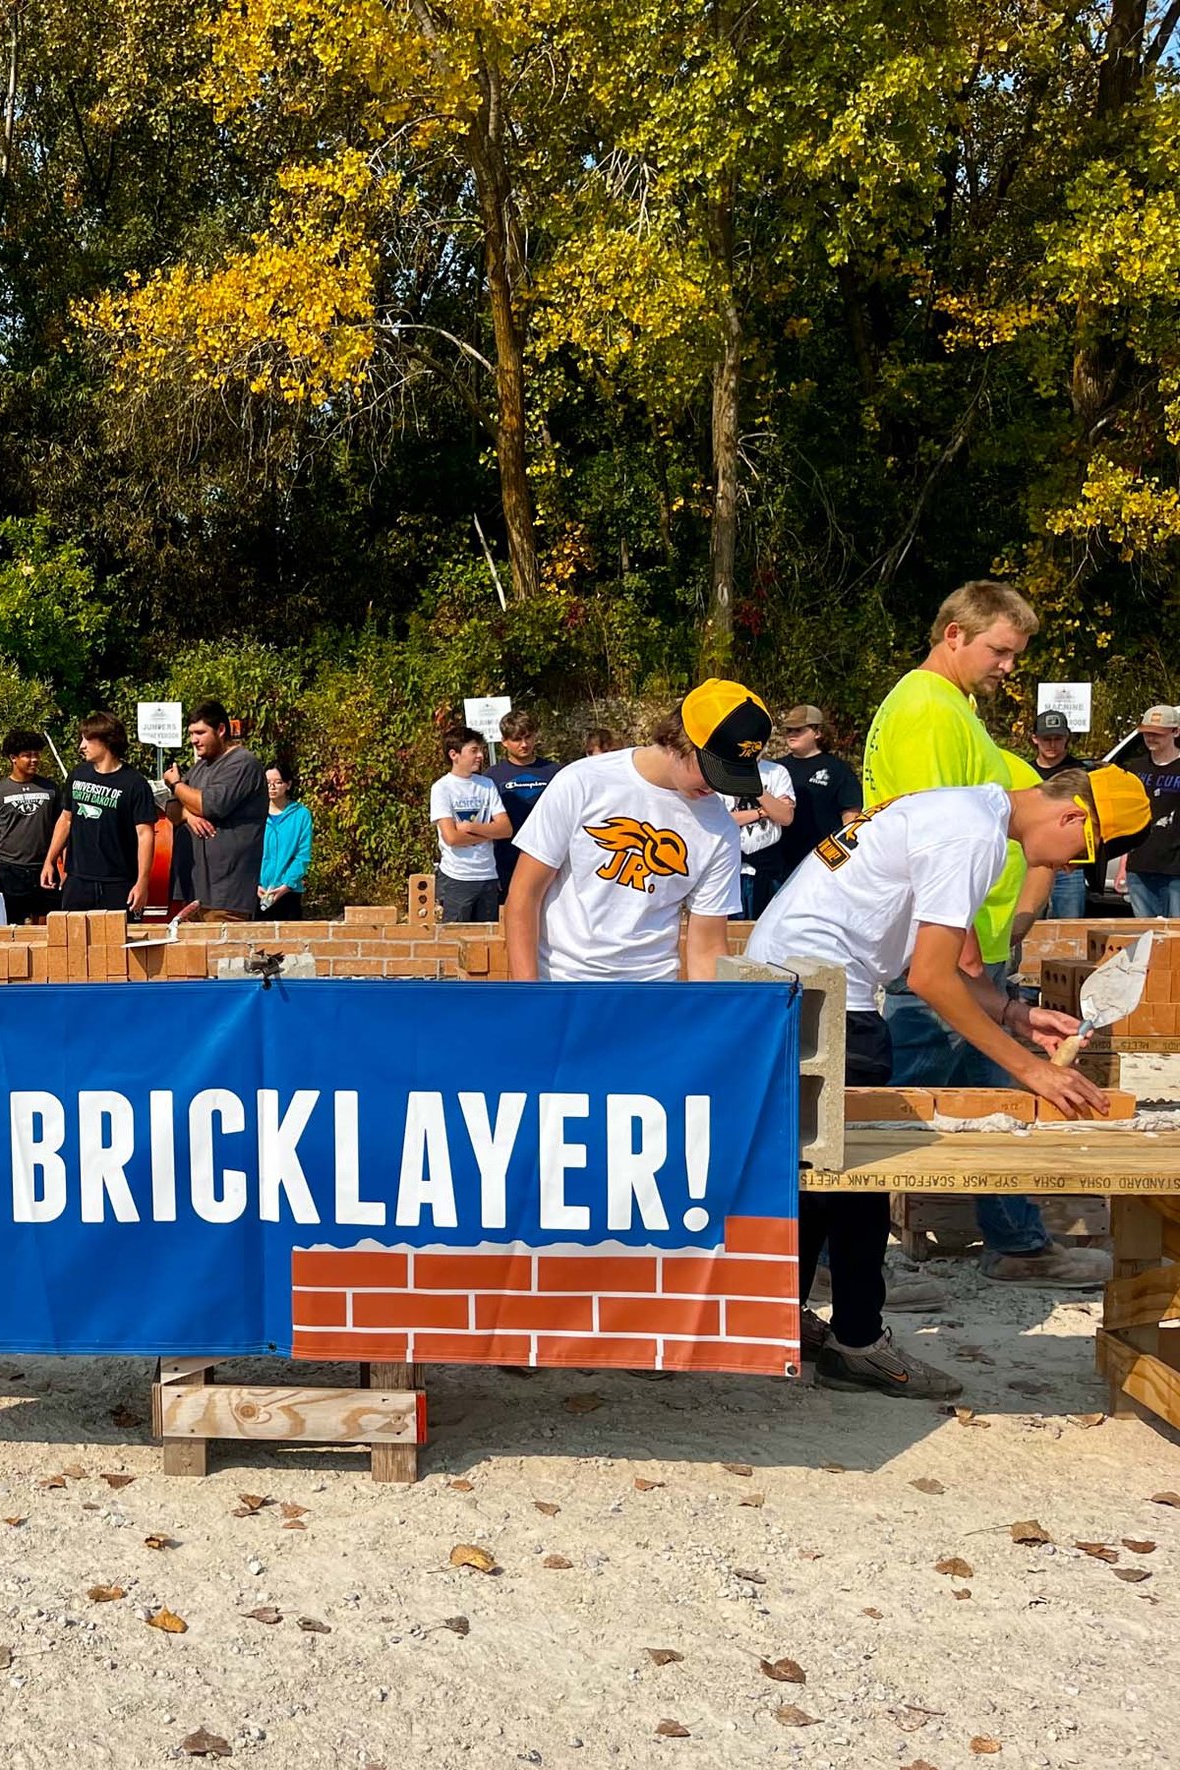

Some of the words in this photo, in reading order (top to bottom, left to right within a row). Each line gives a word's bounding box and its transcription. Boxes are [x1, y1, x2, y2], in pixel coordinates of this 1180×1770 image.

[72, 780, 112, 797] UNIVERSITY
[110, 788, 123, 799] OF
[505, 781, 548, 791] Champion
[90, 795, 118, 809] DAKOTA
[595, 849, 656, 894] JR.
[9, 1087, 711, 1233] BRICKLAYER!
[800, 1174, 840, 1186] MEETS
[848, 1174, 886, 1186] PLANK
[893, 1175, 955, 1187] SCAFFOLD
[963, 1176, 988, 1187] MSR
[994, 1177, 1019, 1188] SYP
[1033, 1177, 1065, 1189] OSHA
[1080, 1177, 1111, 1189] OSHA
[1119, 1177, 1180, 1189] STANDARD
